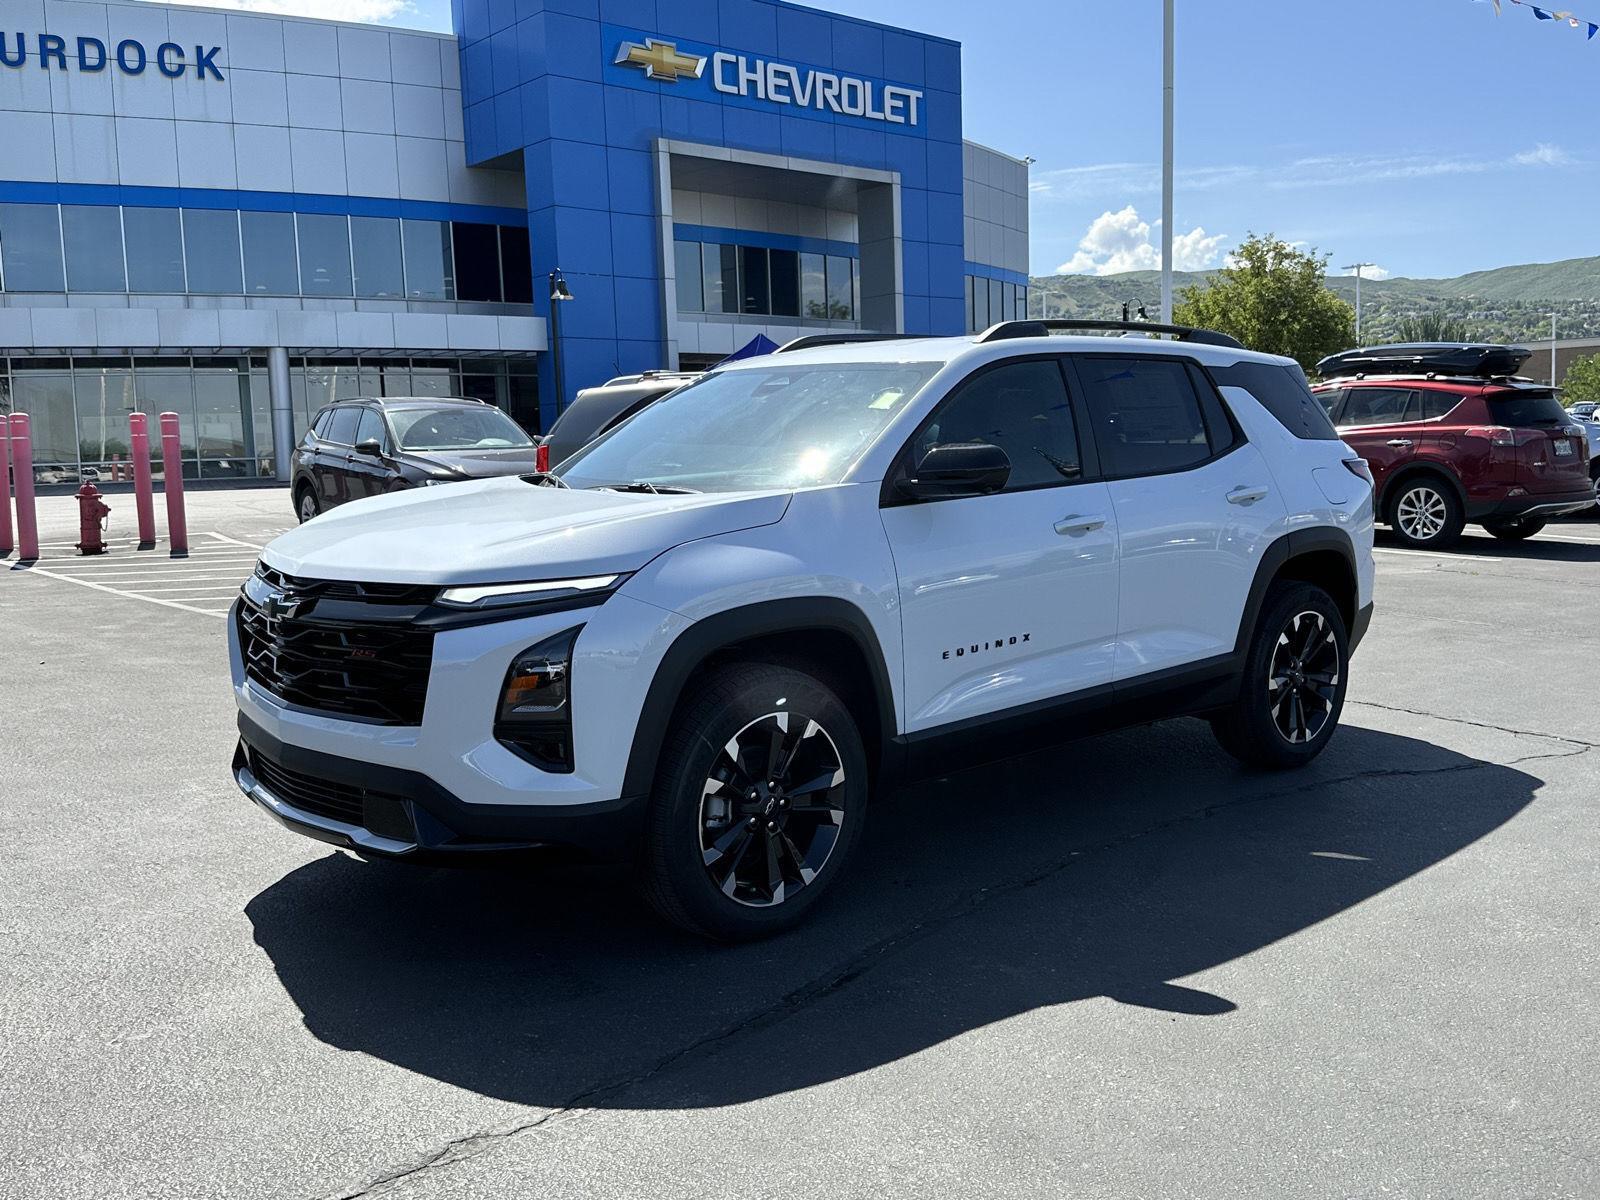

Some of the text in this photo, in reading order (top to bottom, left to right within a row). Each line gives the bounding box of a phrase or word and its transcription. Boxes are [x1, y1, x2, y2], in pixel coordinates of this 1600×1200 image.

[0, 31, 225, 81] URDOCK
[713, 51, 923, 126] CHEVROLET
[942, 633, 1030, 660] EQUINOX
